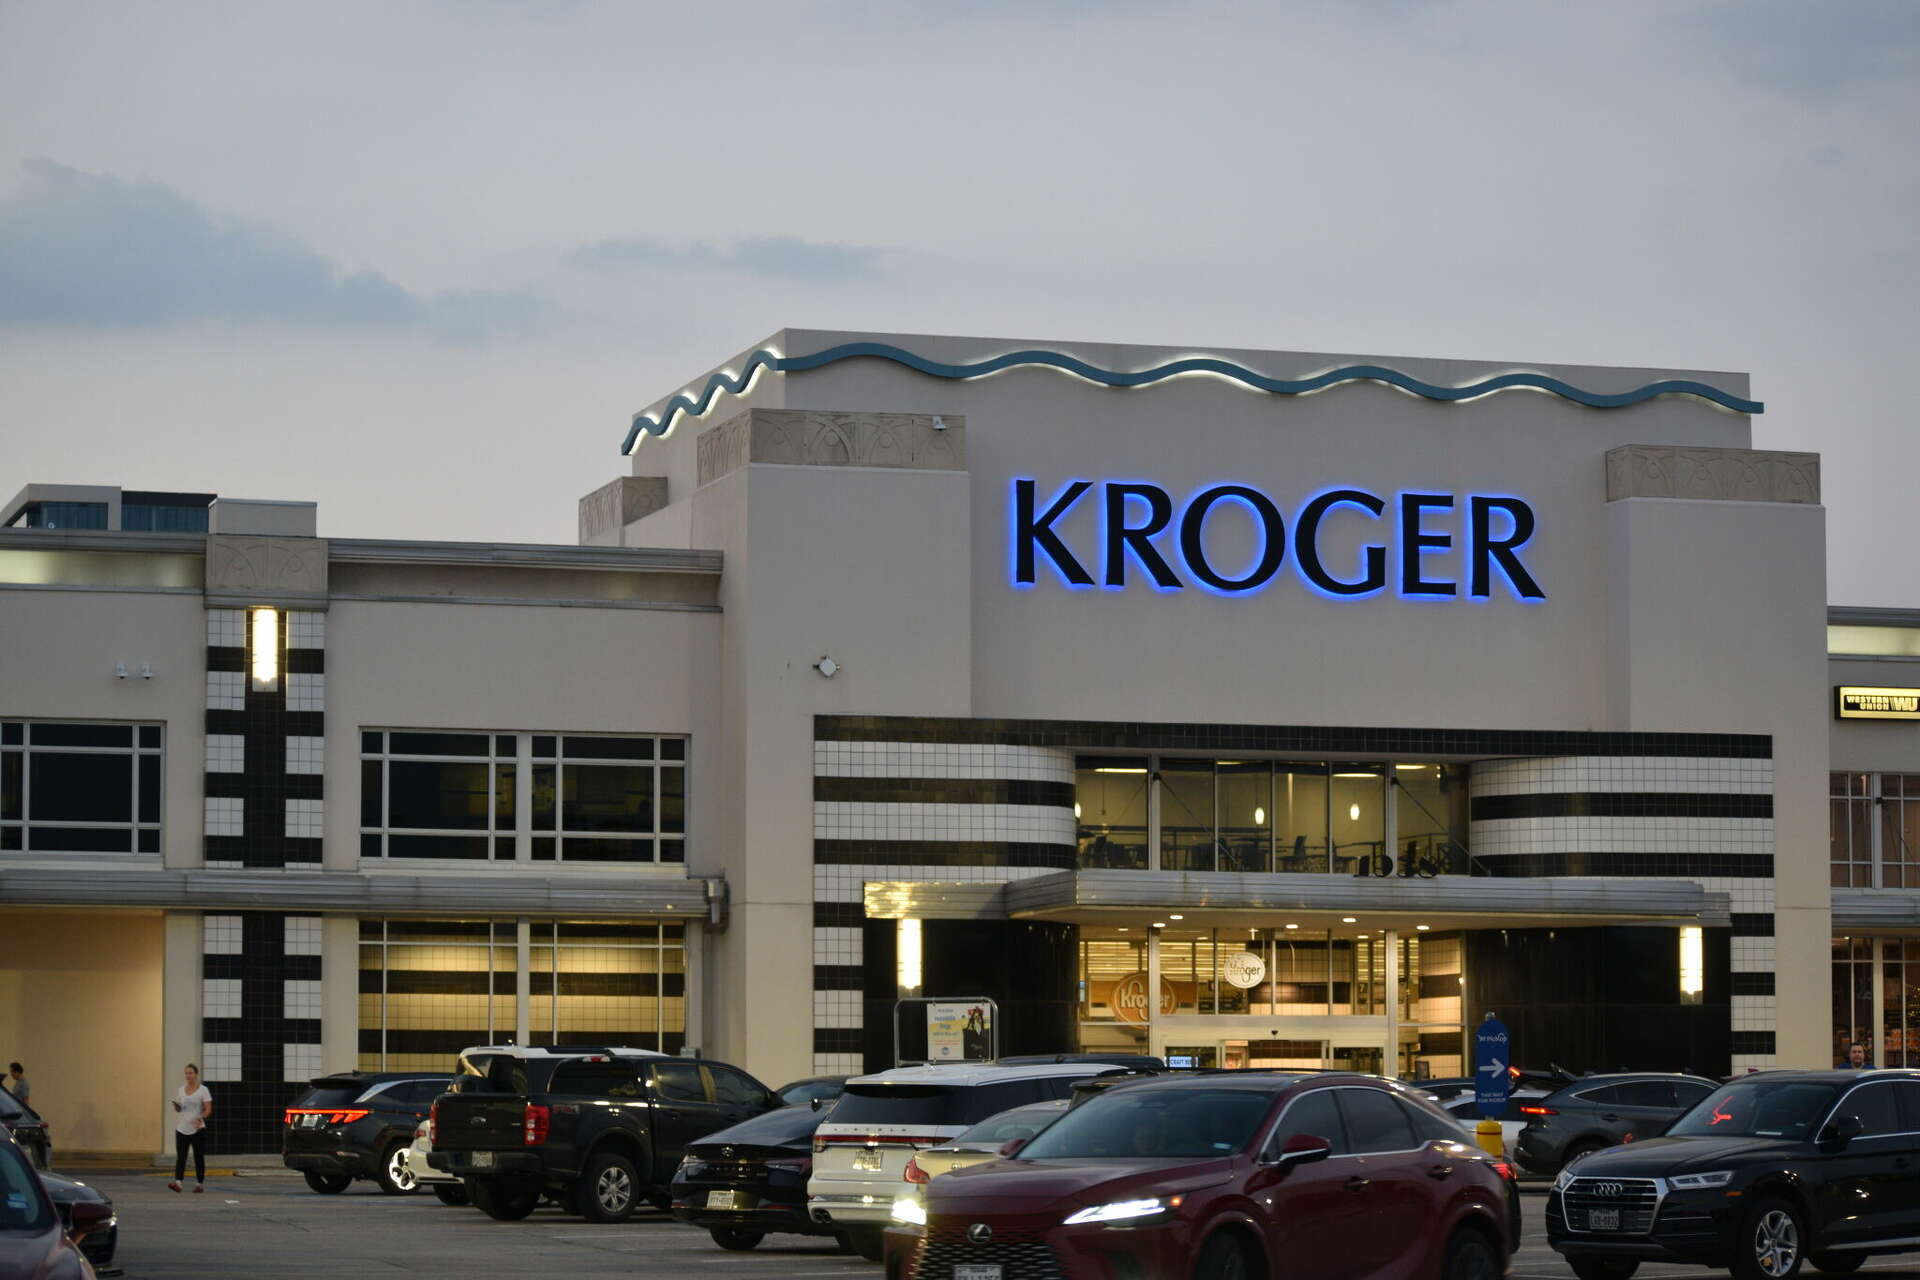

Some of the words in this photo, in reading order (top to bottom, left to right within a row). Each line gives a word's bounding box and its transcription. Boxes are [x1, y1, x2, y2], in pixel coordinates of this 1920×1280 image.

[1015, 479, 1546, 600] KROGER
[1846, 695, 1889, 704] WESTERN
[1893, 697, 1918, 712] WU
[1860, 702, 1889, 711] UNION
